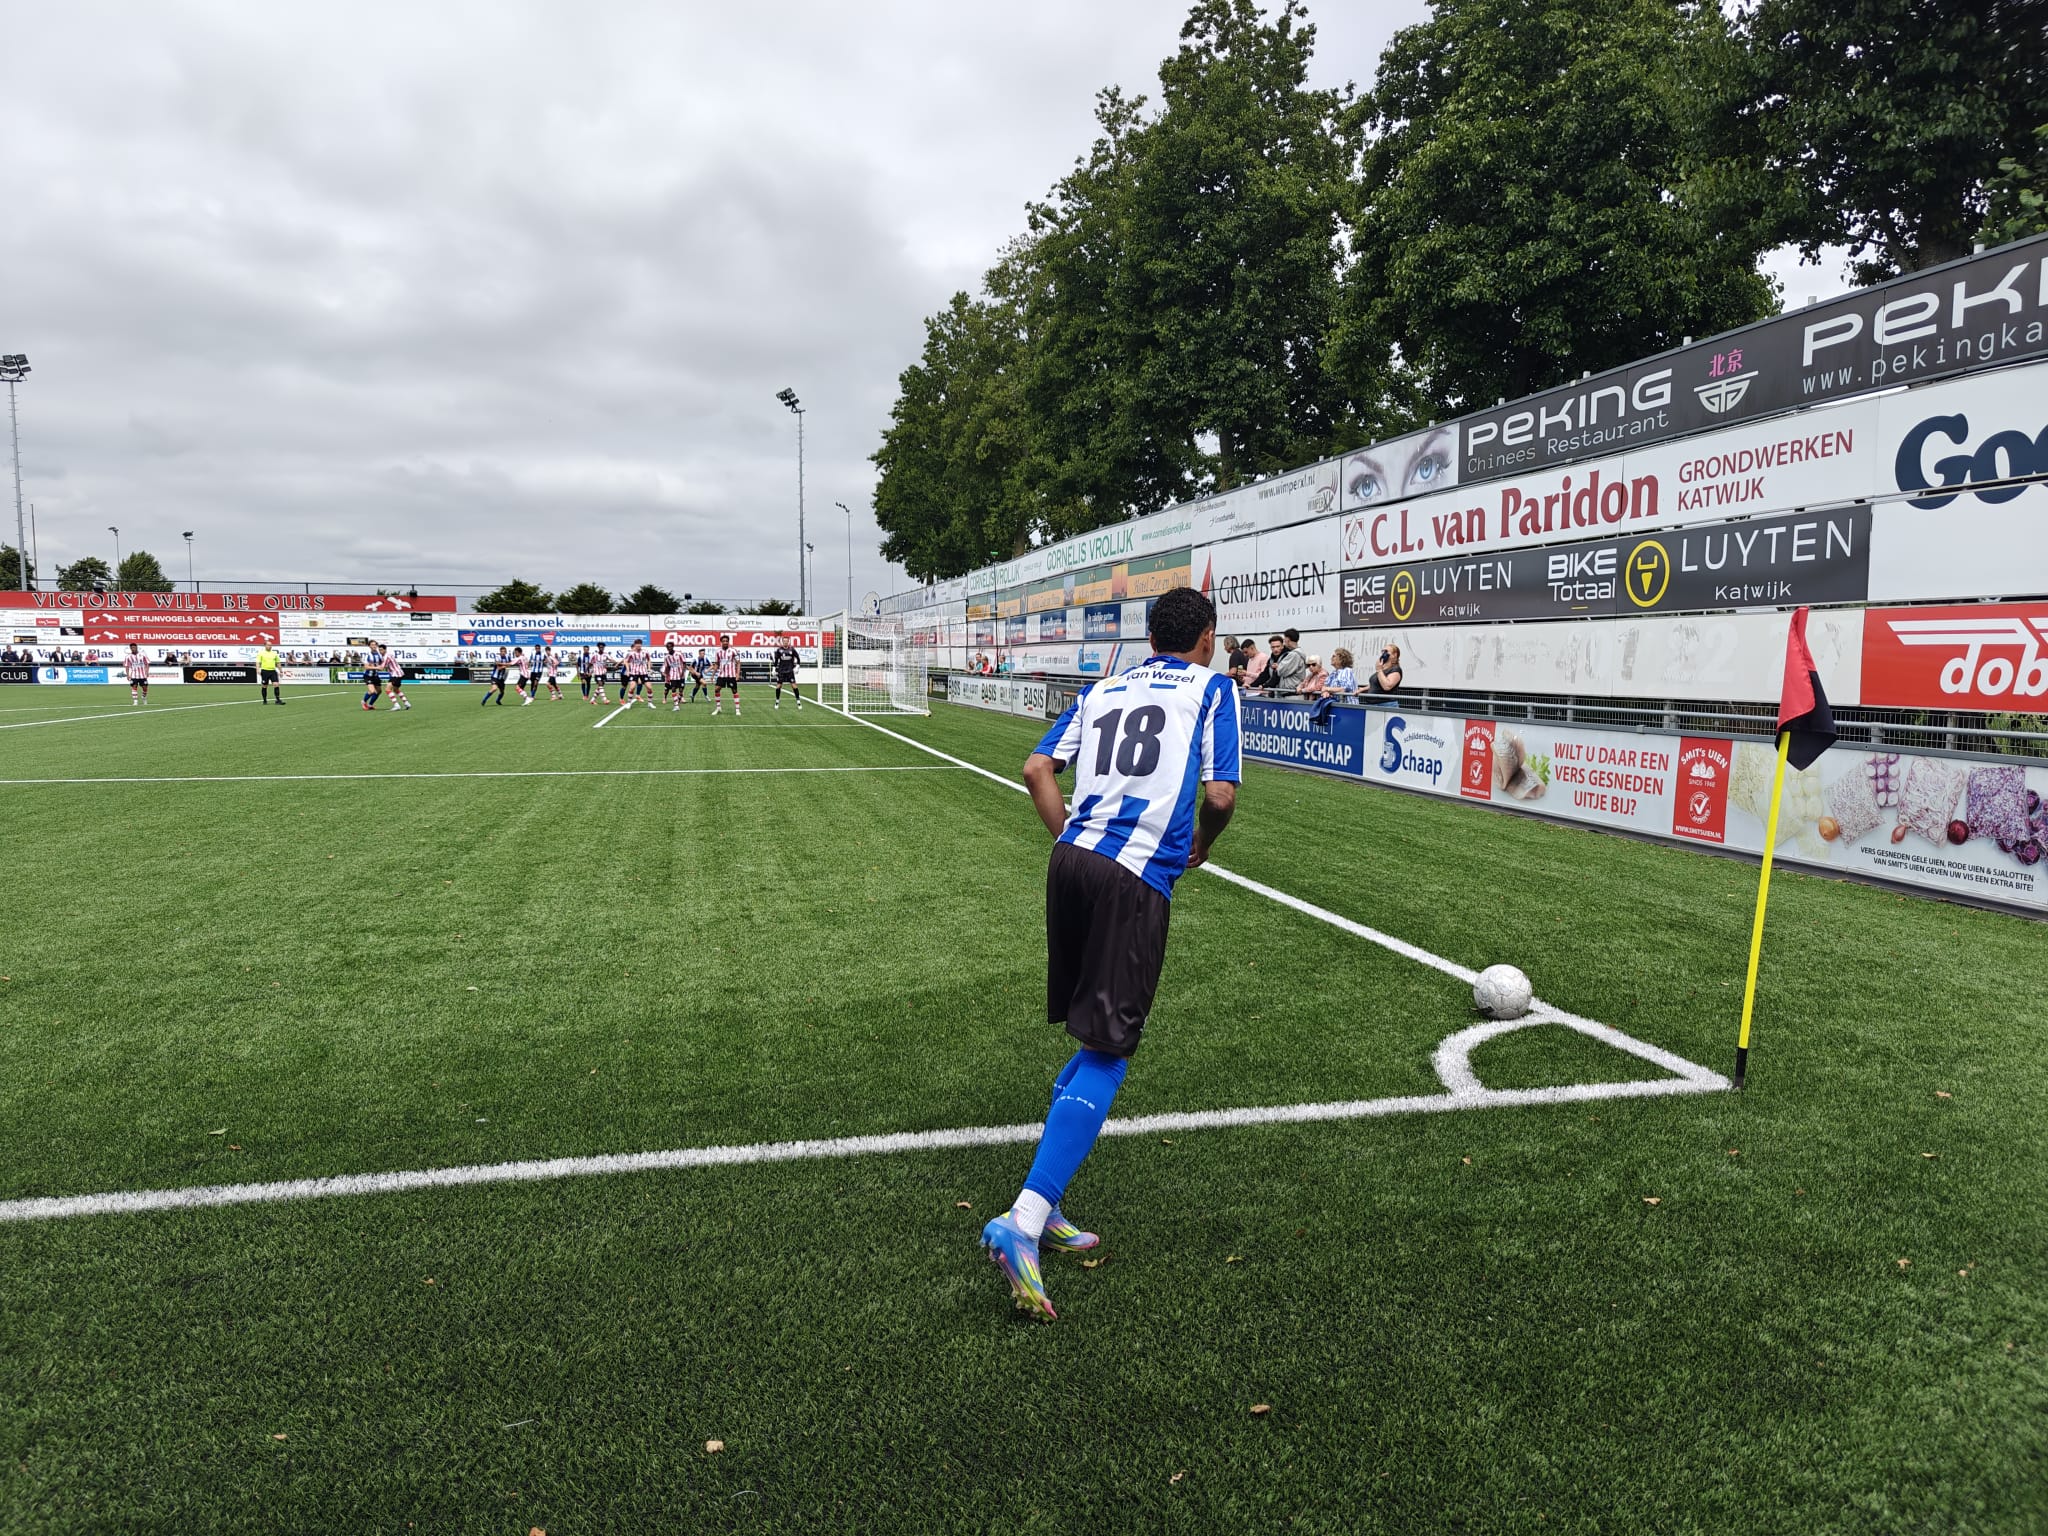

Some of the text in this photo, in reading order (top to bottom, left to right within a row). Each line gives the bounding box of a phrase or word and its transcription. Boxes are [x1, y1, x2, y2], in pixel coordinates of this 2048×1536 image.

[1709, 348, 1744, 378] 北京
[1467, 410, 1669, 473] Chinees Restaurant
[1678, 429, 1854, 483] GRONDWERKEN
[1678, 476, 1765, 511] KATWIJK
[1370, 470, 1659, 557] C.L. van Paridon
[1046, 528, 1134, 571] CORNELIS VROLIJK
[1681, 518, 1854, 572] LUYTEN
[1548, 548, 1617, 579] BIKE
[1219, 560, 1325, 605] GRIMBERGEN
[1344, 575, 1386, 598] BIKE
[1421, 560, 1512, 596] LUYTEN
[1547, 577, 1617, 602] Totaal
[1715, 580, 1792, 601] Katwijk
[31, 592, 326, 610] VICTORY WILL BE OURS
[1344, 597, 1385, 615] Totaal
[1439, 603, 1481, 617] Katwijk
[141, 615, 193, 623] RIJNVOGELS
[469, 616, 564, 628] vandersnoek
[477, 635, 511, 643] GEBRA
[664, 632, 716, 646] Axxon
[208, 649, 228, 659] life
[394, 649, 417, 659] Plas
[0, 671, 28, 680] CLUB
[1152, 670, 1196, 684] Wezel
[1024, 687, 1044, 709] BASIS
[1263, 709, 1277, 728] 1-0
[1280, 709, 1310, 732] VOOR
[1093, 705, 1166, 777] 18
[1303, 739, 1352, 767] SCHAAP
[1554, 742, 1669, 772] WILT U DAAR EEN
[1708, 749, 1728, 769] UIEN
[1555, 765, 1664, 796] VERS GESNEDEN
[1574, 790, 1637, 816] UITJE BIJ?
[1860, 846, 1876, 855] VERS
[1876, 849, 1911, 861] GESNEDEN
[1911, 855, 1928, 864] GELE
[1948, 861, 1967, 870] RODE
[1968, 864, 1985, 874] UIEN
[1993, 868, 2034, 882] SJALOTTEN
[1873, 857, 1887, 866] VAN
[1909, 863, 1925, 872] UIEN
[1925, 866, 1949, 877] GEVEN
[1949, 869, 1961, 879] UW
[1962, 872, 1974, 881] VIS
[1975, 874, 1989, 884] EEN
[1990, 877, 2014, 889] EXTRA
[2015, 881, 2034, 892] BITE!
